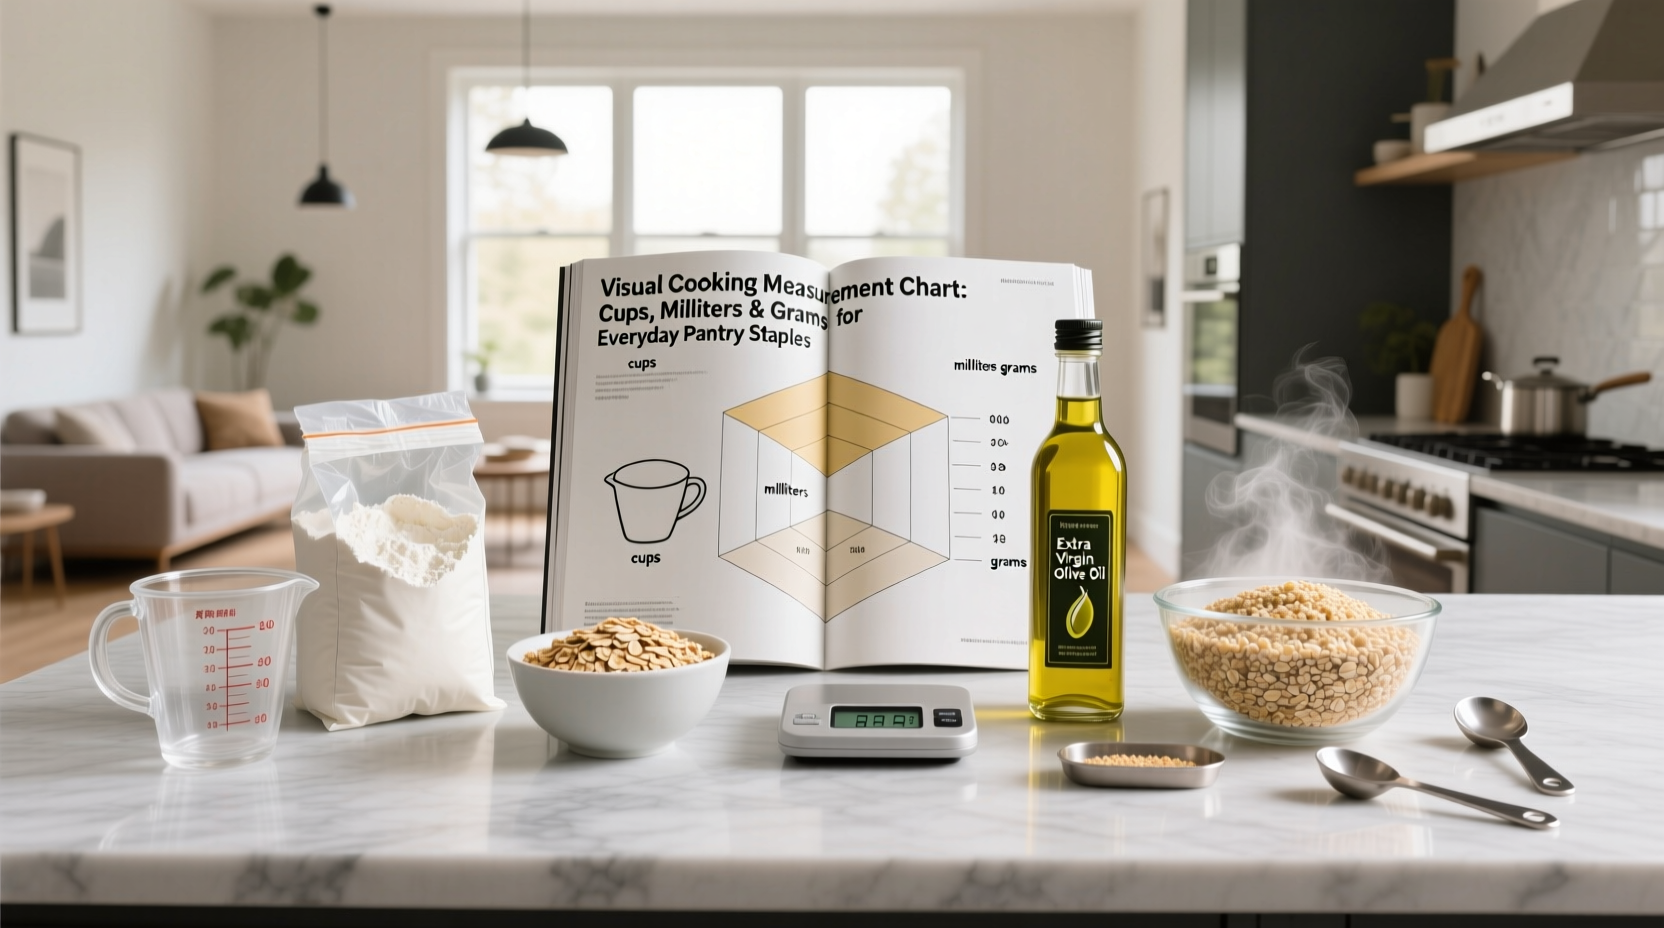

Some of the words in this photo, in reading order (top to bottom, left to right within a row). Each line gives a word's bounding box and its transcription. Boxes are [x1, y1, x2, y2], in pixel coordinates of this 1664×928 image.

[601, 274, 663, 297] Visual
[668, 272, 757, 296] Cooking
[763, 273, 894, 305] Measurement
[900, 276, 967, 299] Chart:
[599, 304, 655, 326] Cups,
[660, 298, 742, 319] Milliters
[749, 299, 764, 318] &
[770, 300, 828, 330] Grams
[837, 307, 863, 326] for
[598, 326, 679, 348] Everyday
[683, 325, 744, 346] Pantry
[749, 324, 811, 348] Staples
[628, 358, 657, 371] cups
[1000, 363, 1037, 376] grams
[1056, 536, 1091, 550] Extra
[631, 553, 661, 567] cups
[990, 557, 1028, 570] grams
[1055, 551, 1094, 568] Virgin
[1054, 566, 1086, 580] Olive
[1089, 566, 1106, 580] Oil
